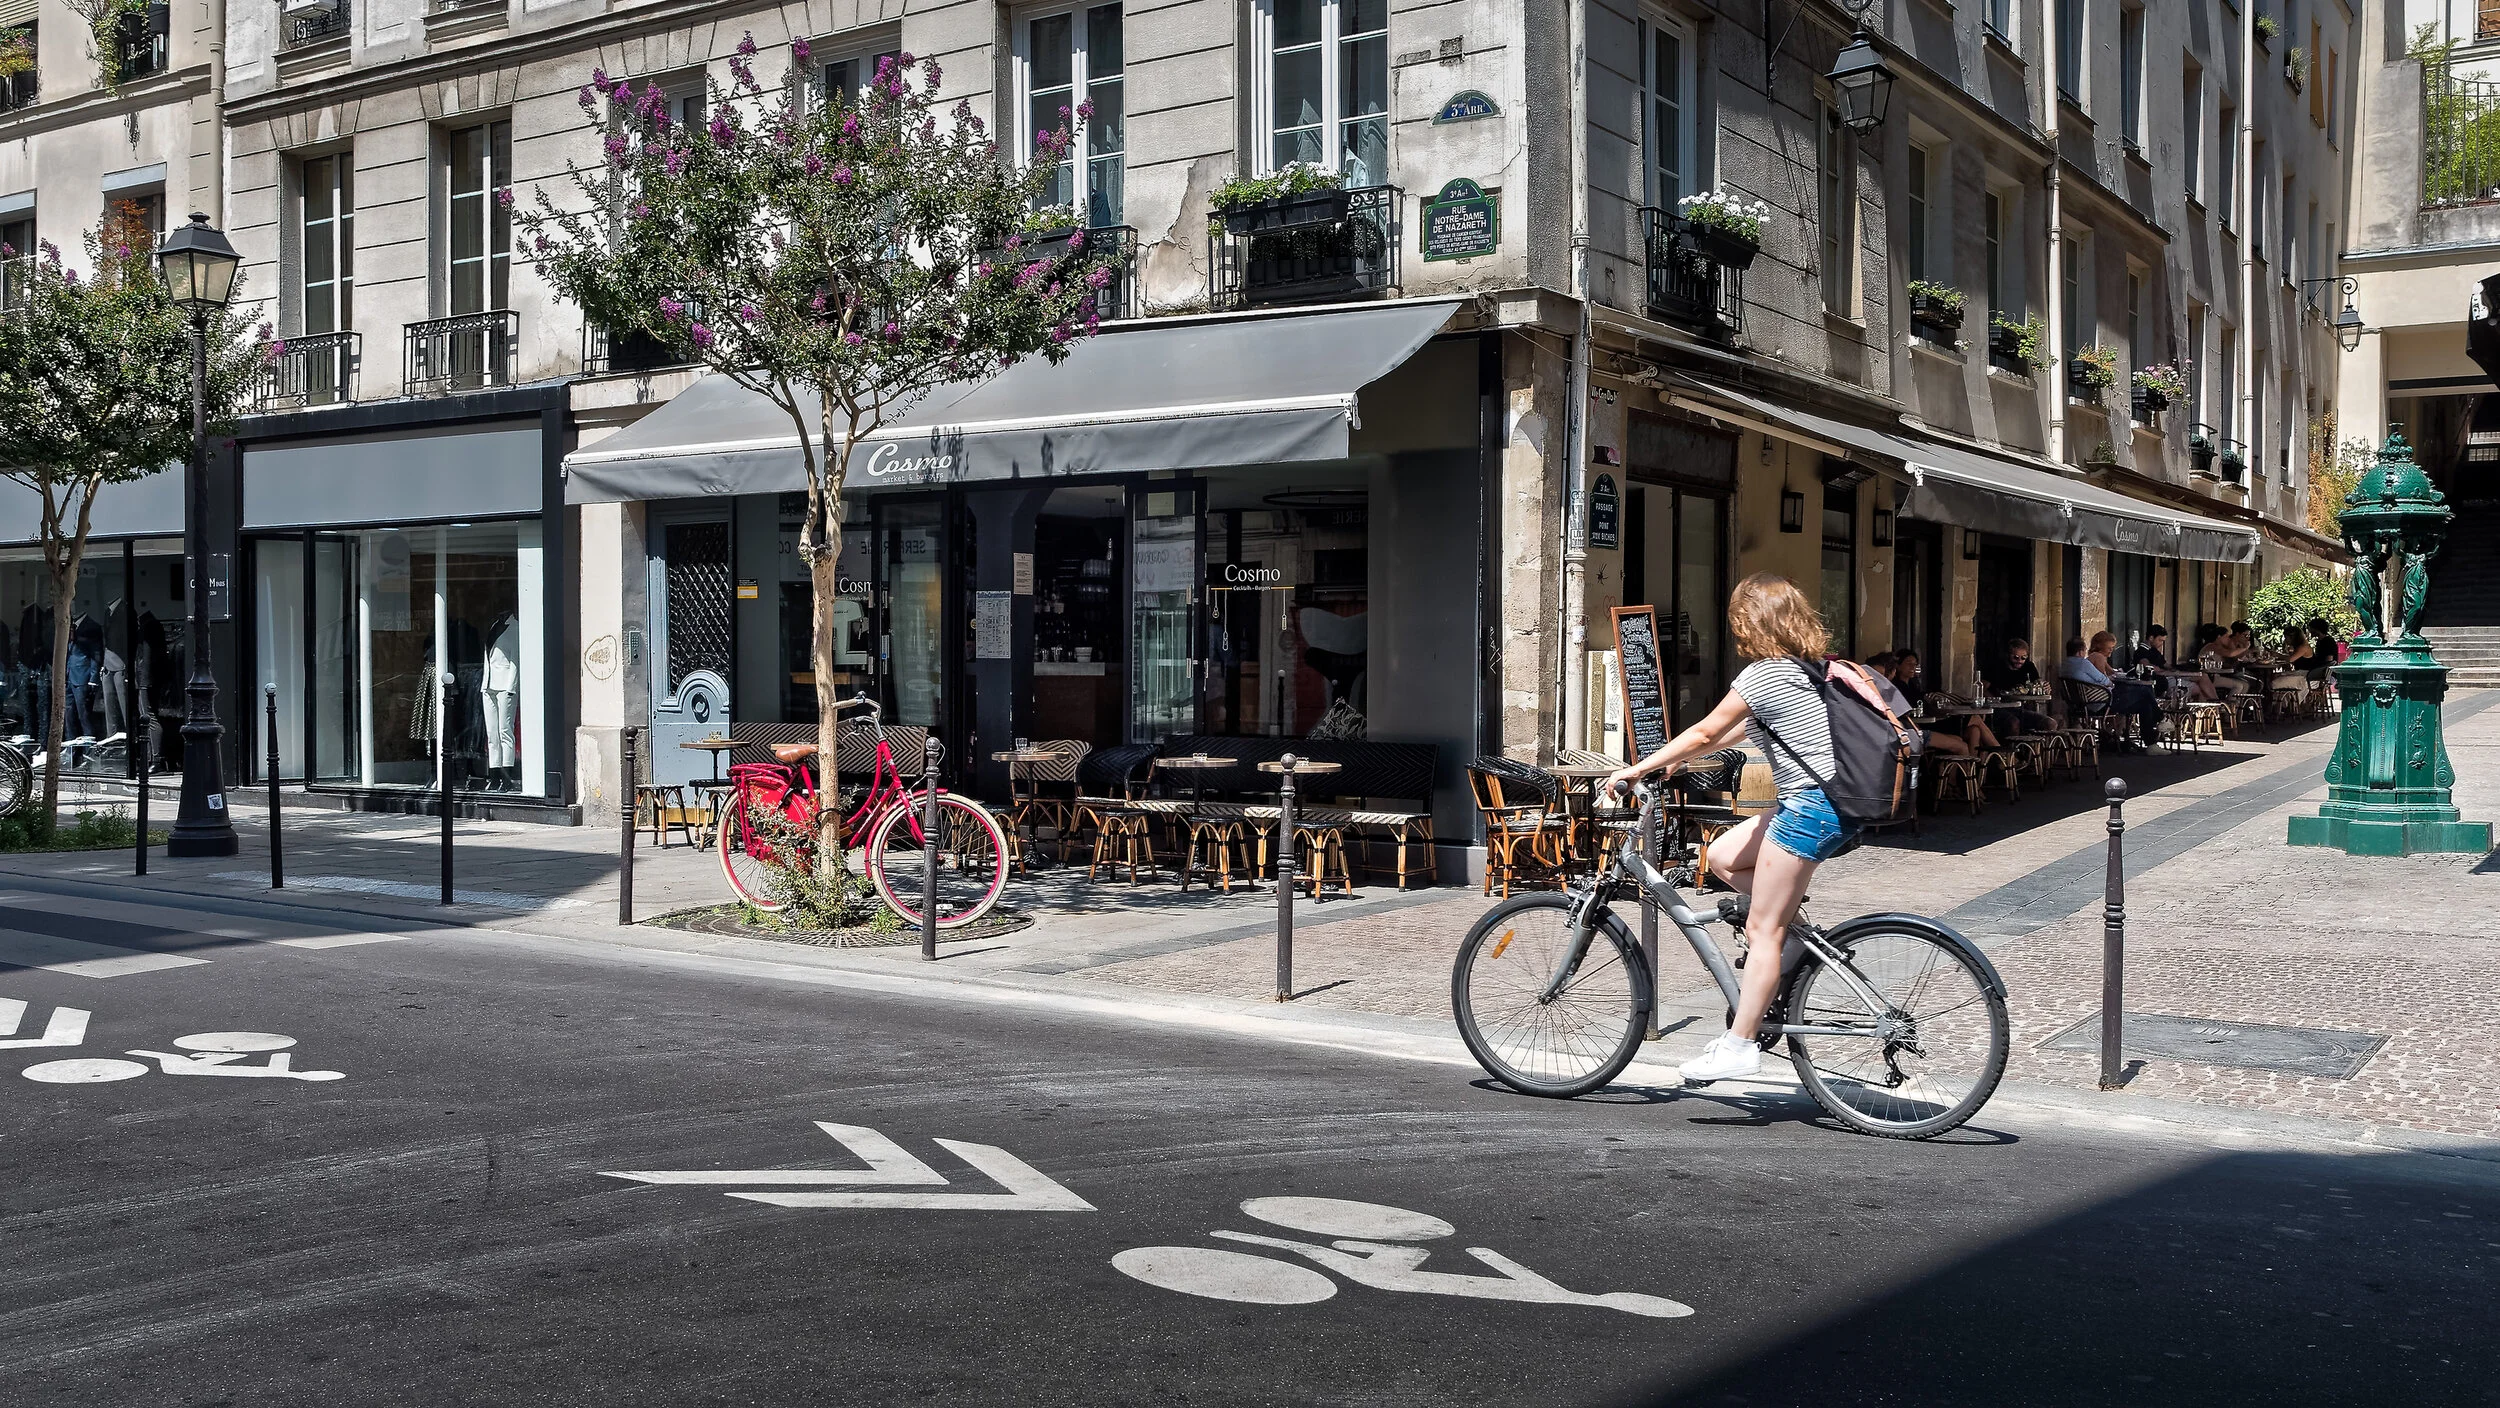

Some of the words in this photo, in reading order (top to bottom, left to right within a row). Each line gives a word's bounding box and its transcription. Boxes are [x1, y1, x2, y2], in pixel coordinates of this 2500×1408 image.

[1452, 205, 1467, 215] RUE
[1434, 211, 1485, 225] NOTRE-DAME
[1432, 225, 1443, 234] DE
[1445, 219, 1487, 232] NAZARETH
[867, 443, 953, 477] Cosmo
[882, 474, 905, 483] market
[1595, 502, 1613, 512] PASSAGE
[2115, 518, 2139, 542] Cosmo
[1225, 564, 1280, 582] Cosmo
